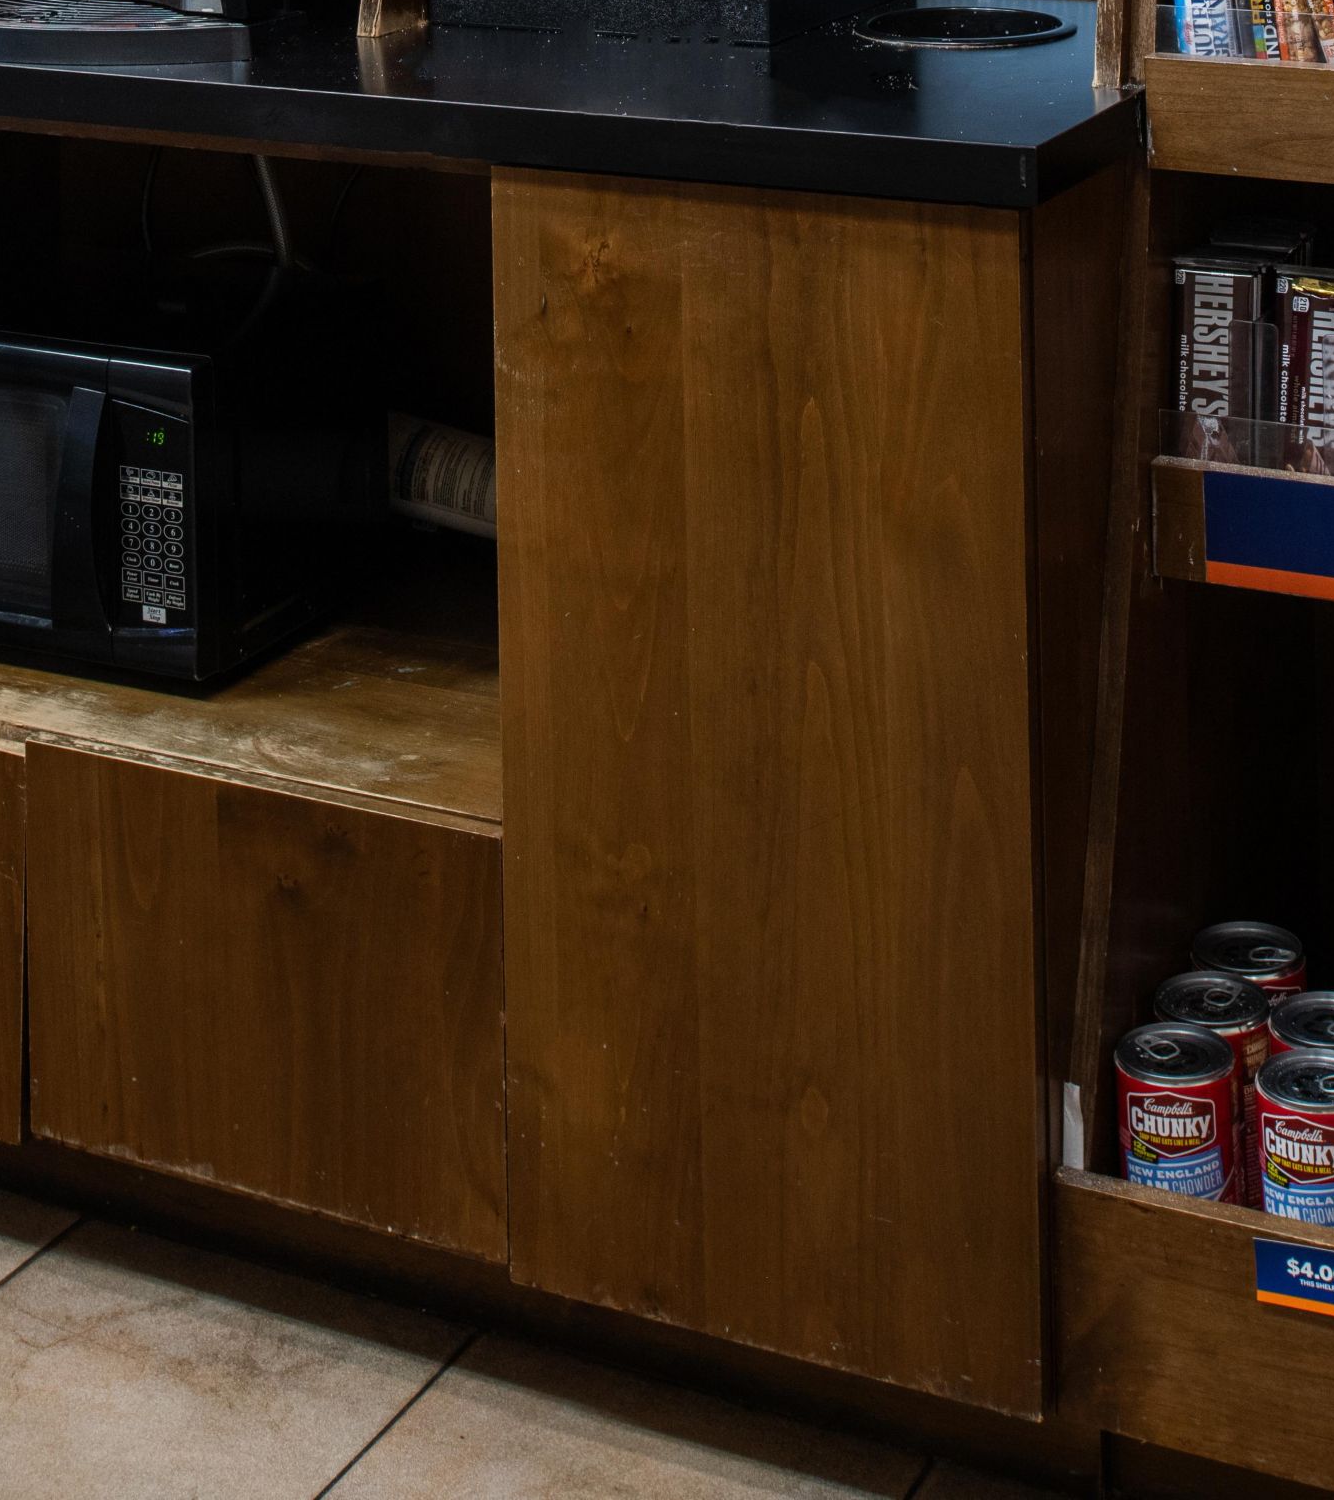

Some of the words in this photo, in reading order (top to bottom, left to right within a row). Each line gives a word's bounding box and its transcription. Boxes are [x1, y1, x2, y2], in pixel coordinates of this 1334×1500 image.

[1191, 273, 1235, 417] HERSHEY'S
[1131, 1106, 1211, 1139] CHUNKY
[1157, 1160, 1220, 1179] ENGLAND
